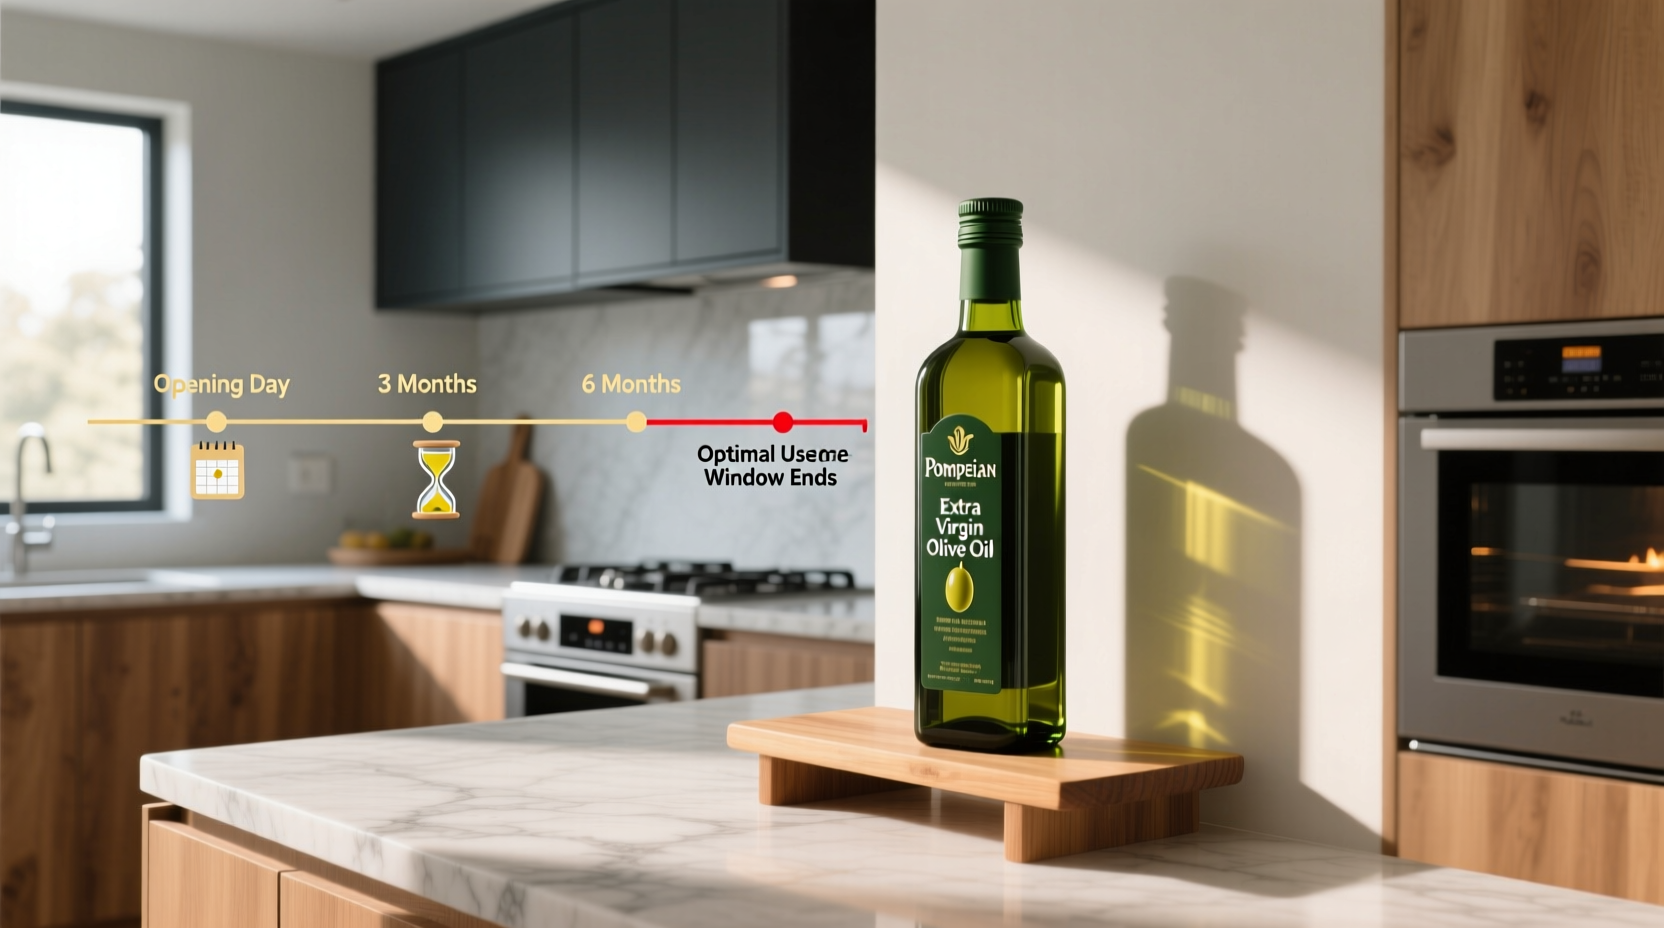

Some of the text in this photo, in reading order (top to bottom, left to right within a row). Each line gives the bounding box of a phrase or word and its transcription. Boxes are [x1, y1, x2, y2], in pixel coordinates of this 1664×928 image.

[940, 498, 982, 516] Extra
[935, 517, 984, 542] Virgin
[926, 538, 994, 559] Olive Oil
